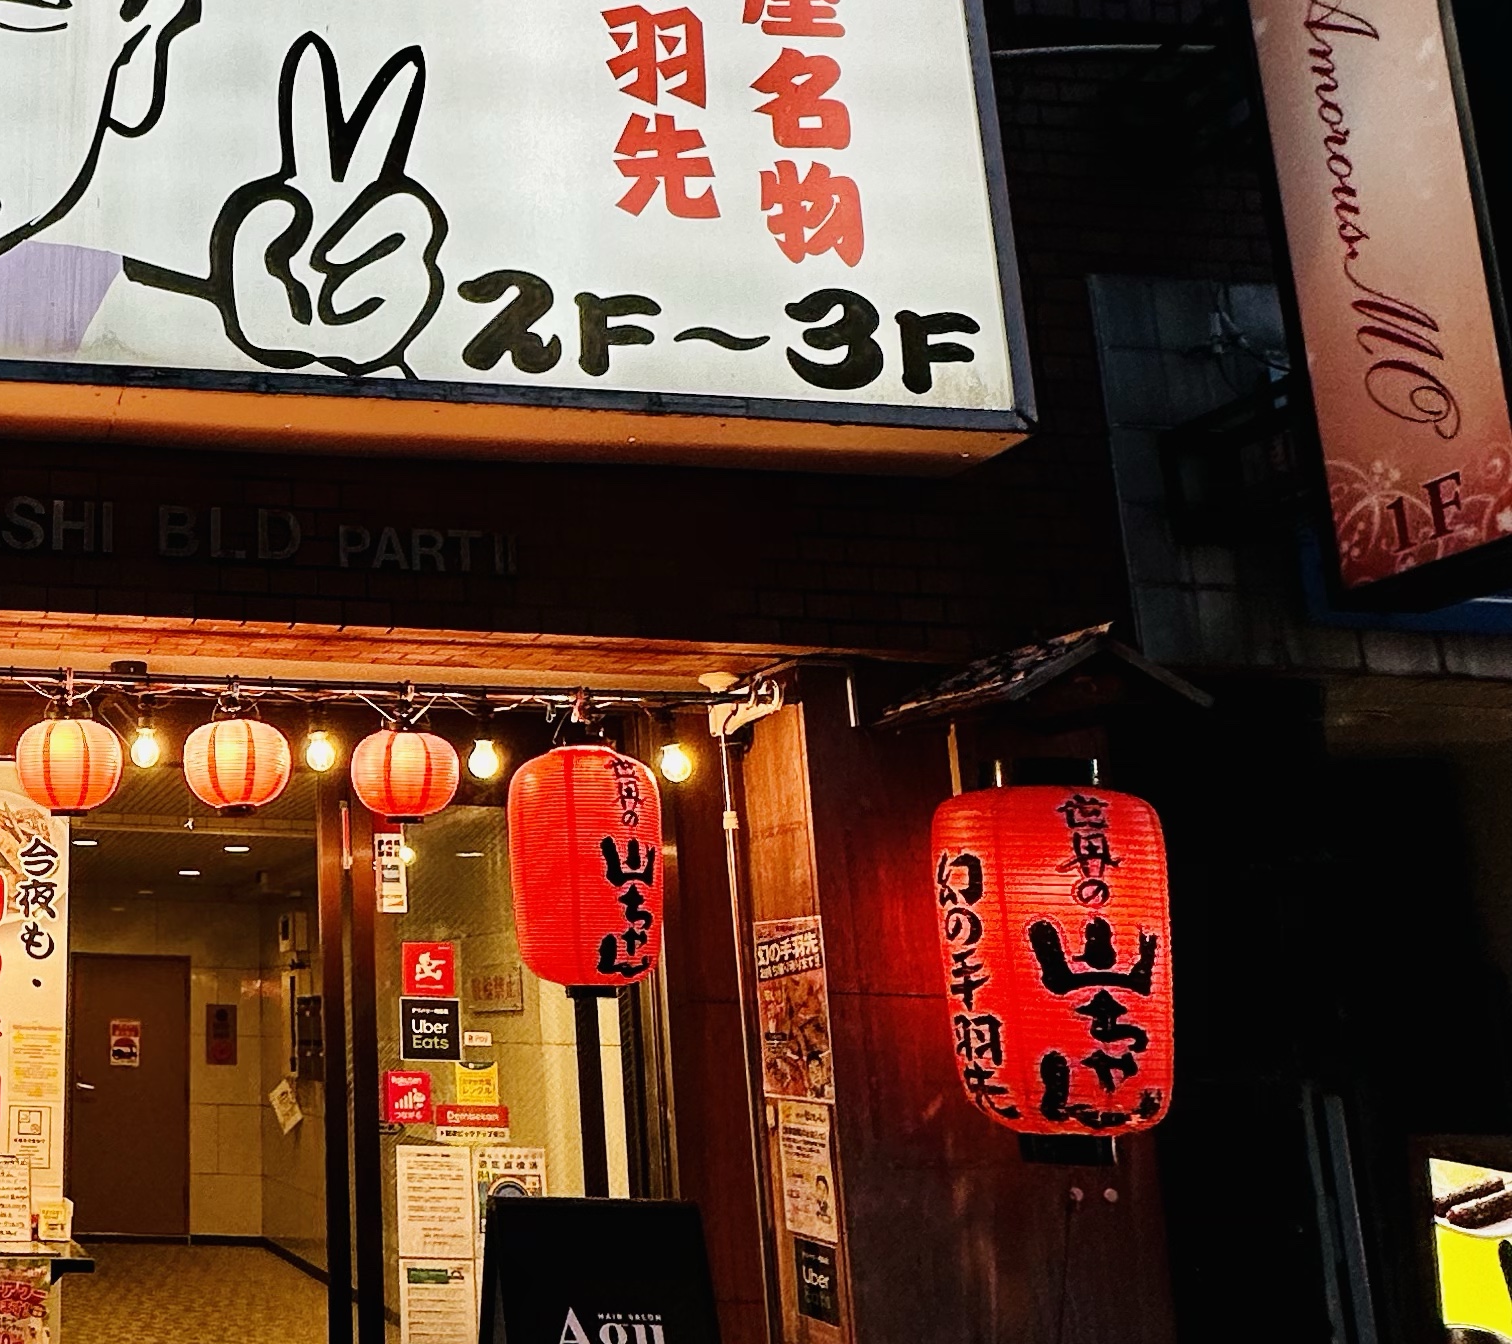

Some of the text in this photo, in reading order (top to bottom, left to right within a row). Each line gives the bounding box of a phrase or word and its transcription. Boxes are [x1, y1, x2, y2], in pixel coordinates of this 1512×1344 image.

[157, 504, 302, 560] BLD
[338, 523, 484, 573] PART
[1386, 470, 1464, 555] 1F
[596, 757, 656, 978] 世界の 山ちゃん
[936, 851, 1021, 1121] 幻の手羽先
[1027, 794, 1163, 1129] 世界の 山ちゃん
[411, 1018, 450, 1034] Uber
[412, 1034, 450, 1050] Eats
